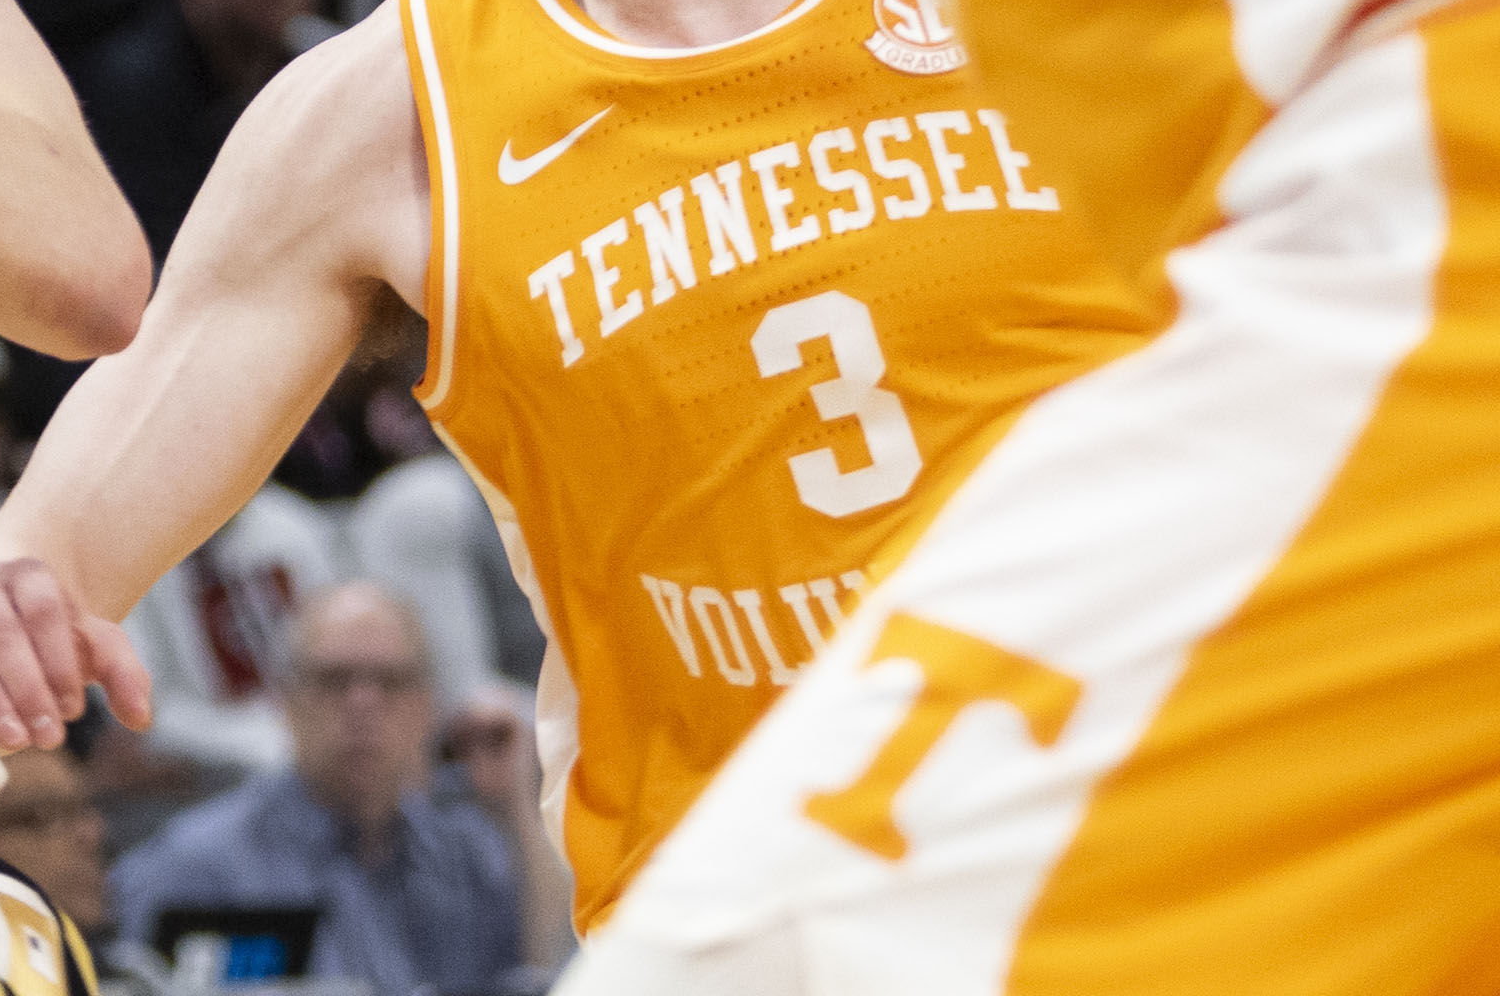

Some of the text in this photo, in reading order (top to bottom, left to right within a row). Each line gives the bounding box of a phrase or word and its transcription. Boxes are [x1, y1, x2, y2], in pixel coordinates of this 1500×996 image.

[884, 45, 966, 71] GRADU
[527, 108, 1062, 368] TENNESSEE
[750, 289, 923, 519] 3
[798, 611, 1088, 862] T
